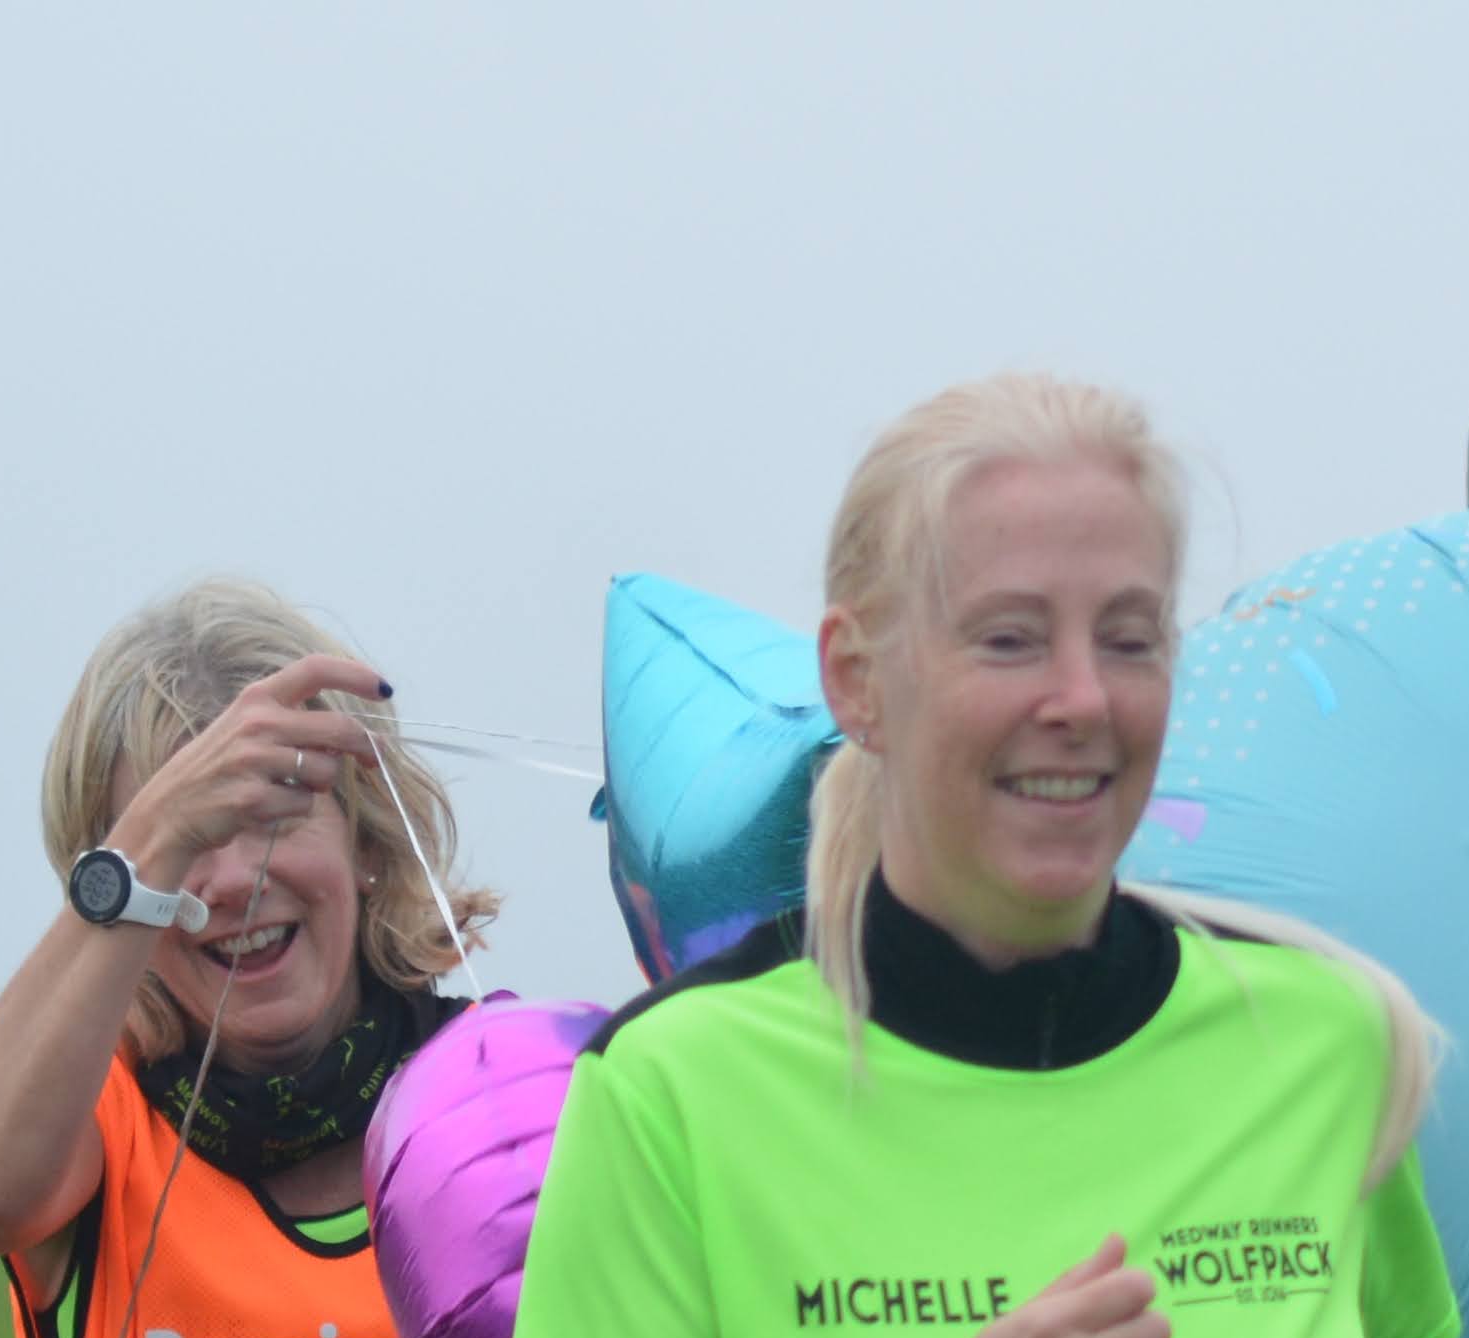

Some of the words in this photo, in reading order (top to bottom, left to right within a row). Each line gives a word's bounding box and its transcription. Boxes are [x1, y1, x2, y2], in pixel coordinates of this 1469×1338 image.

[1159, 1221, 1242, 1248] MEDWAY
[1154, 1240, 1333, 1288] WOLFPACK
[793, 1277, 1013, 1327] MICHELLE
